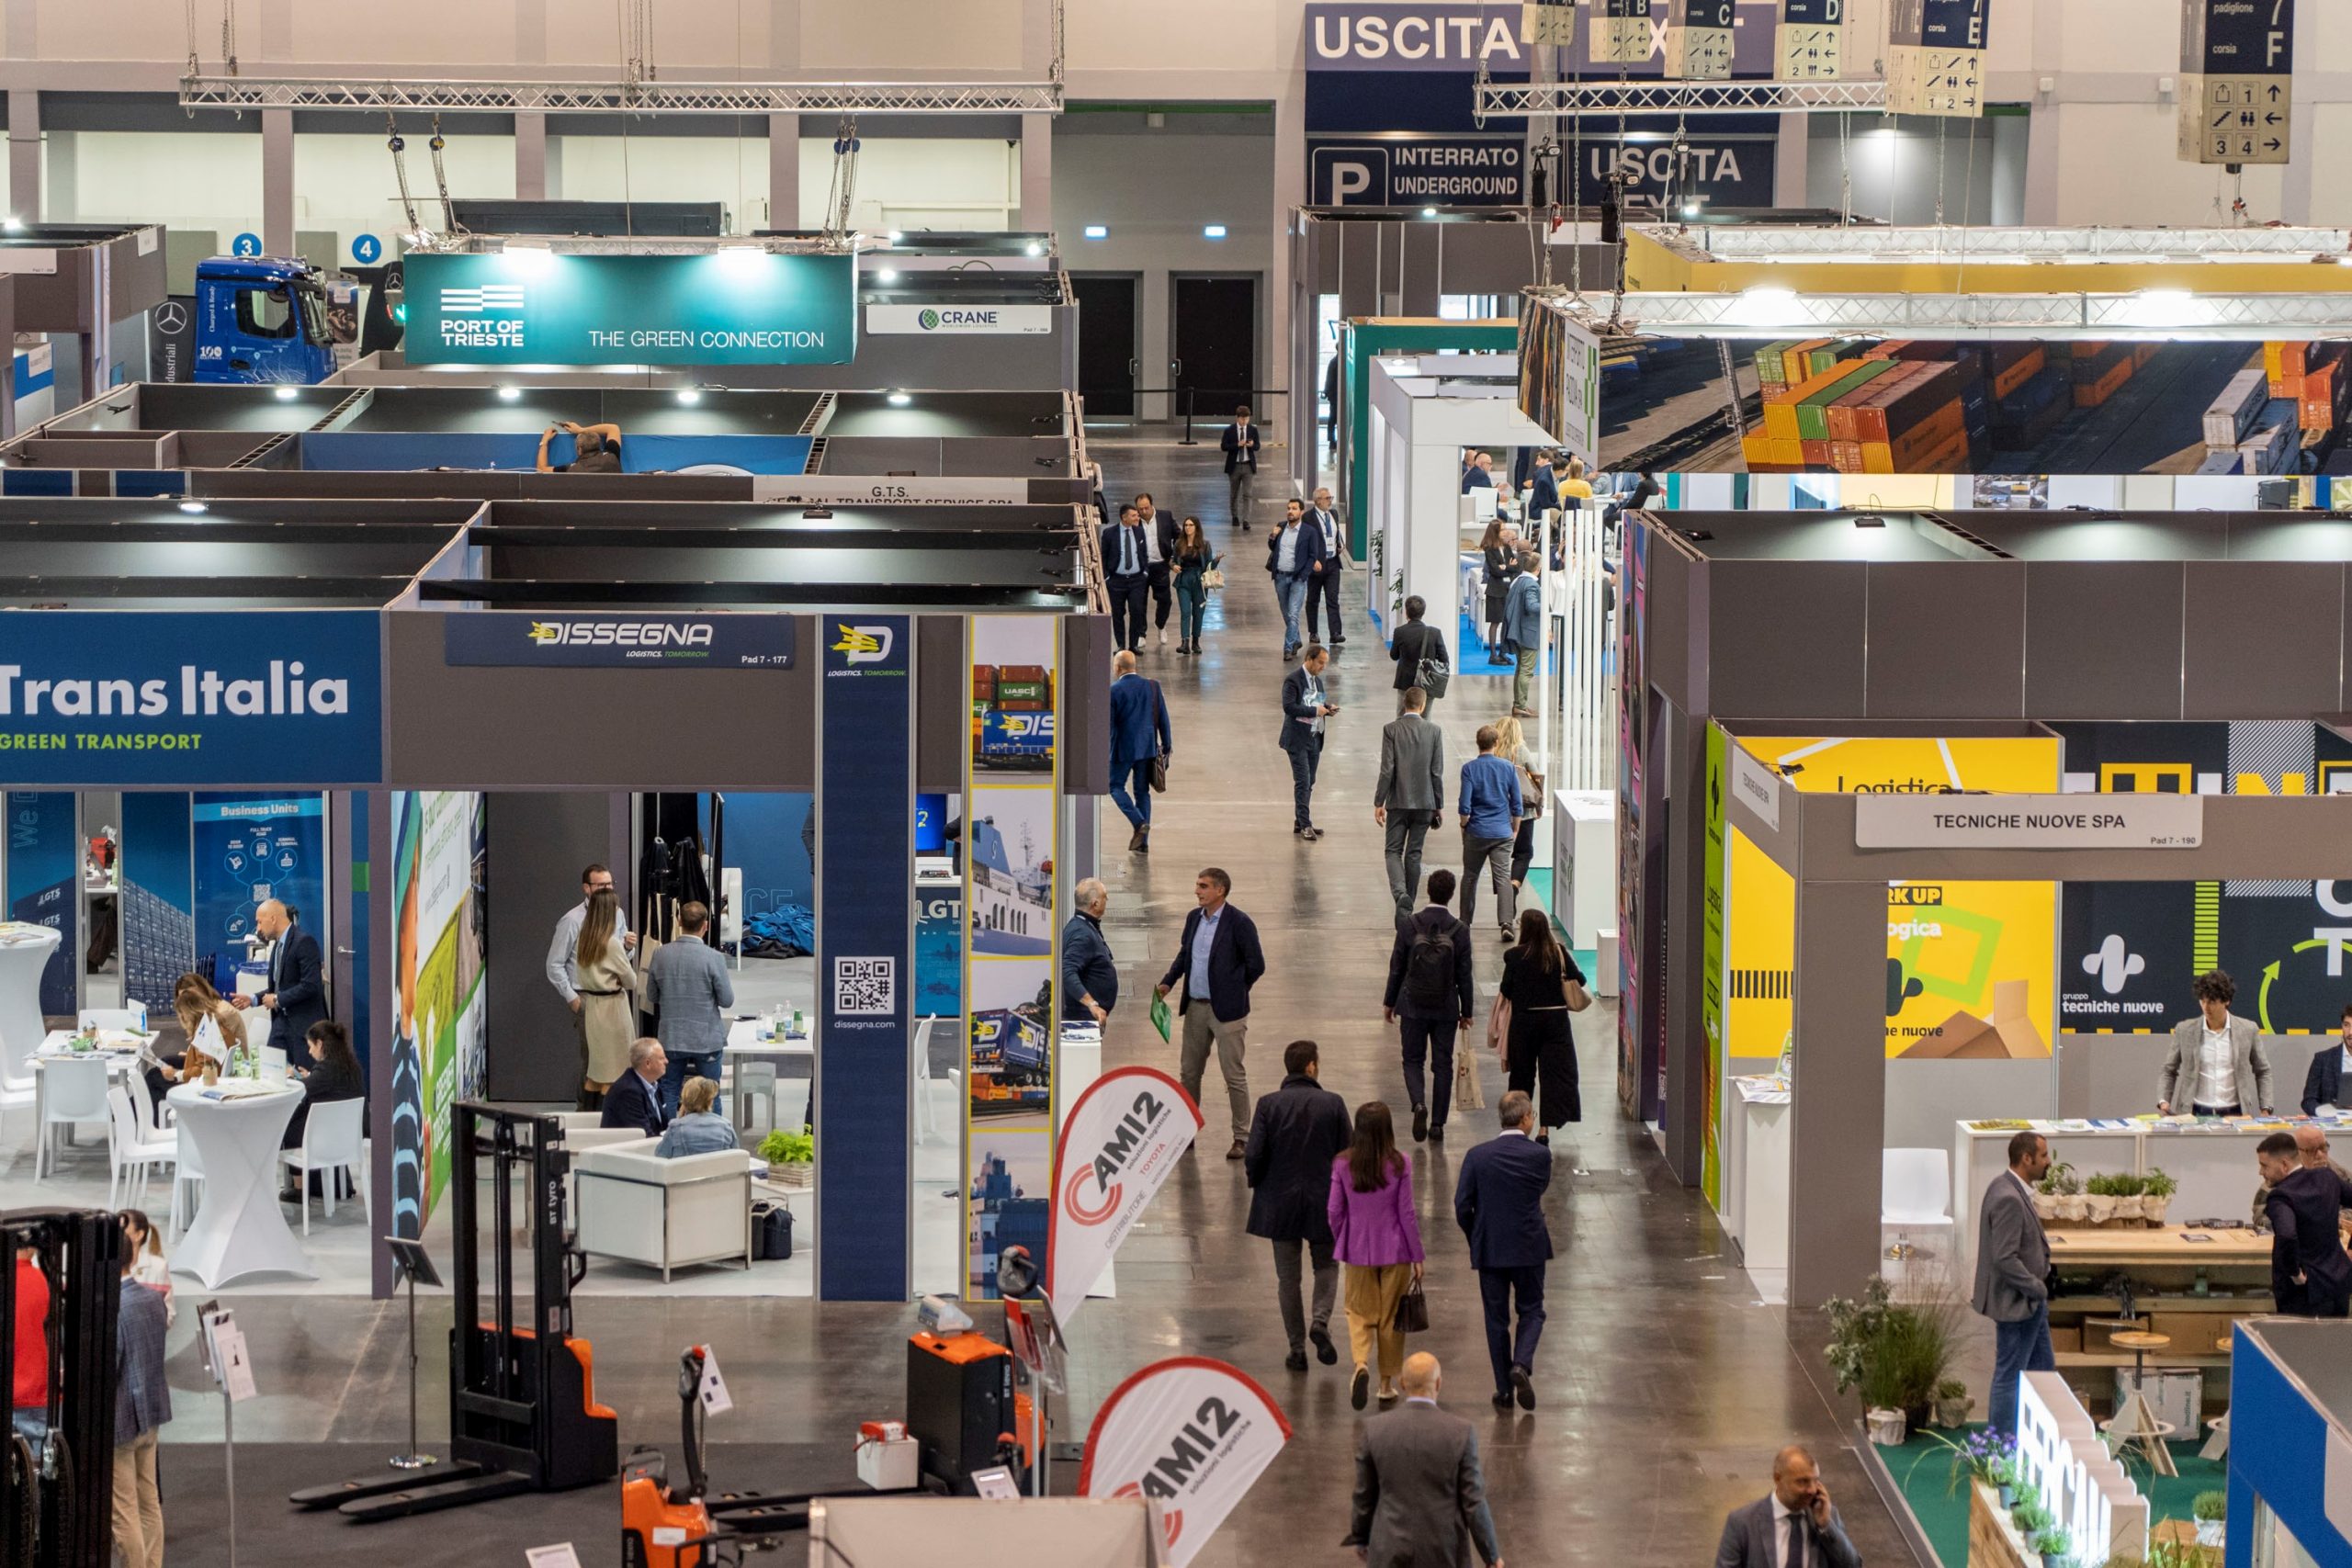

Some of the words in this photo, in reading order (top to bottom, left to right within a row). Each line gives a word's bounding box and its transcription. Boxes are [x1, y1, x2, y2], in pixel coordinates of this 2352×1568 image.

[1719, 4, 1731, 25] C
[1826, 0, 1838, 21] D
[2213, 4, 2255, 16] padiglione
[1315, 16, 1521, 59] USCITA
[1928, 24, 1947, 32] corsia
[1968, 17, 1983, 44] E
[2212, 43, 2237, 54] corsia
[2267, 31, 2284, 67] F
[1704, 65, 1711, 73] 2
[1792, 66, 1800, 76] 2
[1928, 97, 1935, 108] 1
[1947, 98, 1955, 109] 2
[2245, 89, 2251, 103] 1
[2216, 140, 2226, 154] 3
[2242, 141, 2252, 155] 4
[1394, 147, 1520, 167] INTERRATO
[1394, 175, 1519, 196] UNDERGROUND
[241, 239, 253, 256] 3
[360, 241, 373, 257] 4
[941, 311, 998, 324] CRANE
[441, 320, 491, 333] PORT
[495, 320, 525, 333] OF
[440, 333, 525, 347] TRIESTE
[589, 332, 626, 347] THE
[630, 332, 695, 347] GREEN
[700, 332, 824, 348] CONNECTION
[871, 486, 910, 498] G.T.S.
[530, 621, 714, 646] DISSEGNA
[741, 655, 758, 664] Pad
[759, 655, 764, 663] 7
[772, 655, 787, 664] 177
[181, 660, 349, 716] Italia
[75, 733, 202, 750] TRANSPORT
[220, 804, 270, 818] Business
[270, 803, 300, 815] Units
[1933, 814, 2019, 829] TECNICHE
[2026, 814, 2087, 829] NUOVE
[2091, 814, 2127, 829] SPA
[2150, 836, 2166, 846] Pad
[2168, 837, 2174, 845] 7
[2182, 837, 2196, 845] 190
[1912, 887, 1941, 904] UP
[2062, 993, 2089, 1001] gruppo
[2062, 1000, 2120, 1014] tecniche
[2123, 1001, 2165, 1014] nuove
[833, 1020, 896, 1030] dissegna.com
[1902, 1026, 1944, 1037] nuove
[1126, 1140, 1149, 1171] soluzioni
[1148, 1108, 1172, 1142] logistiche
[1139, 1142, 1167, 1177] TOYOTA
[548, 1180, 558, 1210] tyro
